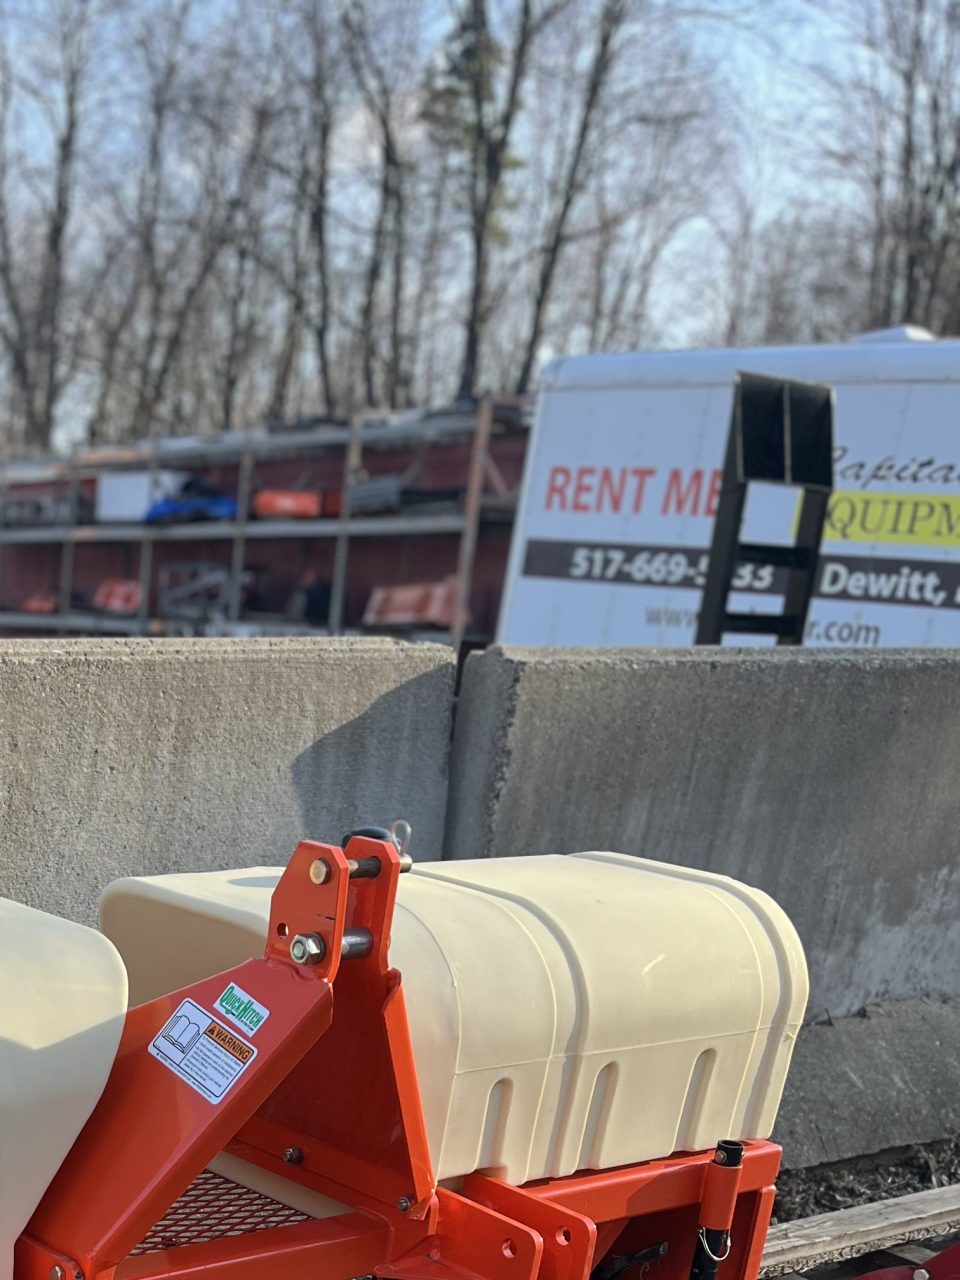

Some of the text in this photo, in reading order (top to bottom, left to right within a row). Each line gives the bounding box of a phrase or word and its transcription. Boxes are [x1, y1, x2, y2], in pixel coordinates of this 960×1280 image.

[833, 446, 960, 488] apita
[544, 466, 656, 514] RENT
[826, 496, 960, 540] QUIPM
[569, 547, 775, 591] 517-669-533
[820, 562, 947, 606] Dewitt,
[214, 1027, 251, 1060] WARNING
